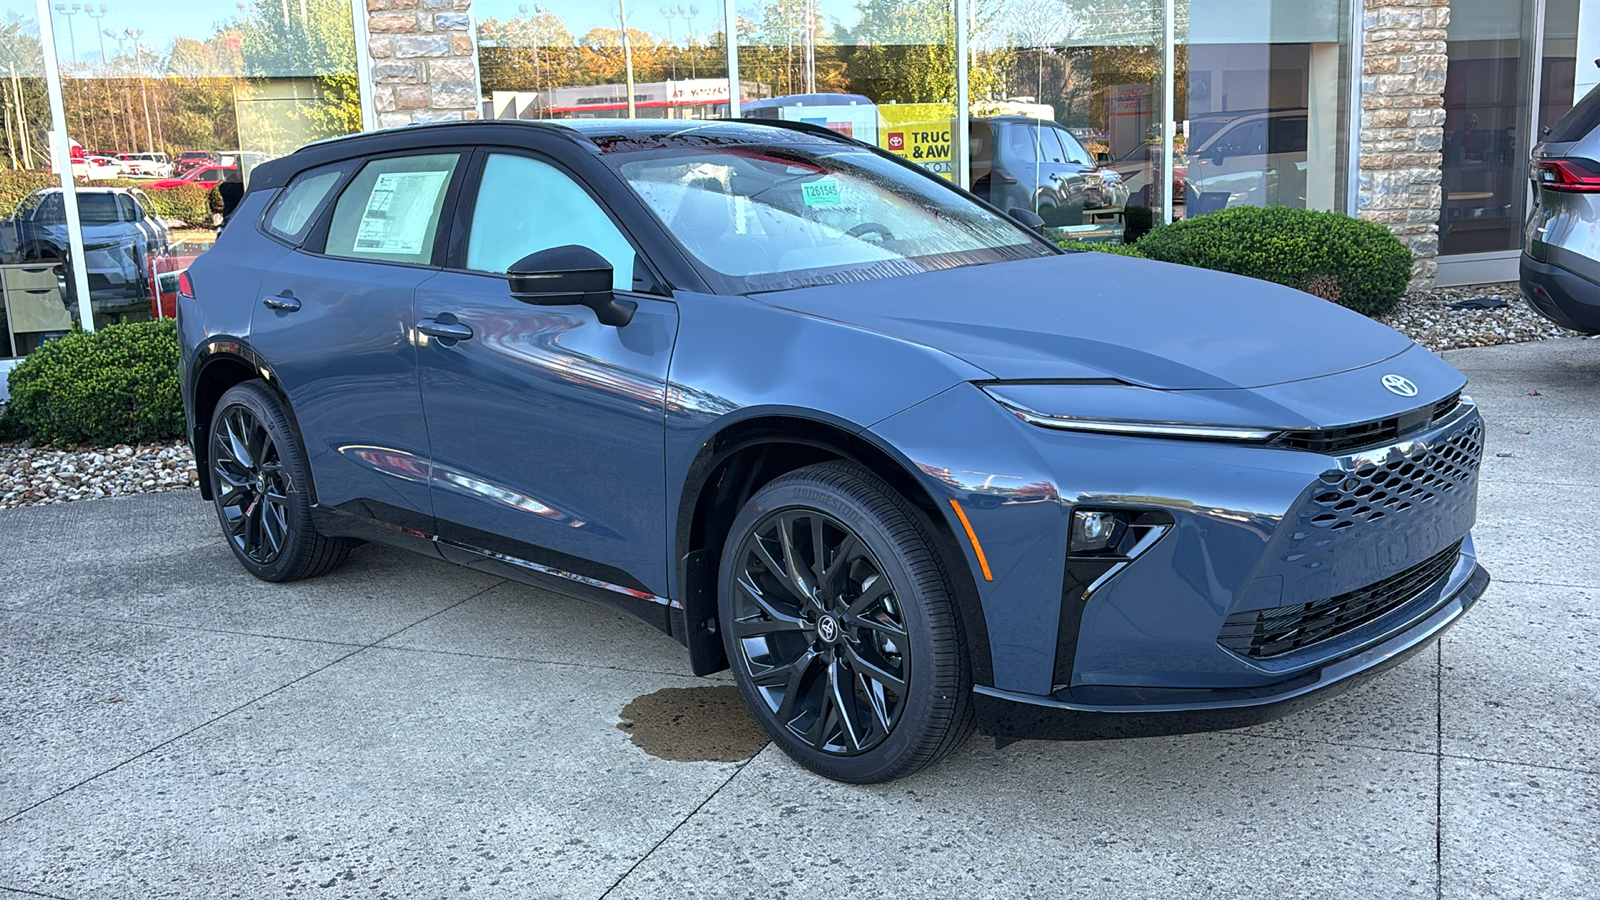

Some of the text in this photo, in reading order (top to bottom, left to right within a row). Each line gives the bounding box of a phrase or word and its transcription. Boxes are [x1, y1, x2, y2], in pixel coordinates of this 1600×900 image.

[912, 131, 950, 143] TRUC
[912, 145, 924, 159] &
[925, 144, 951, 158] AW
[804, 185, 838, 197] T261545
[793, 486, 864, 527] BRIDGESTONE
